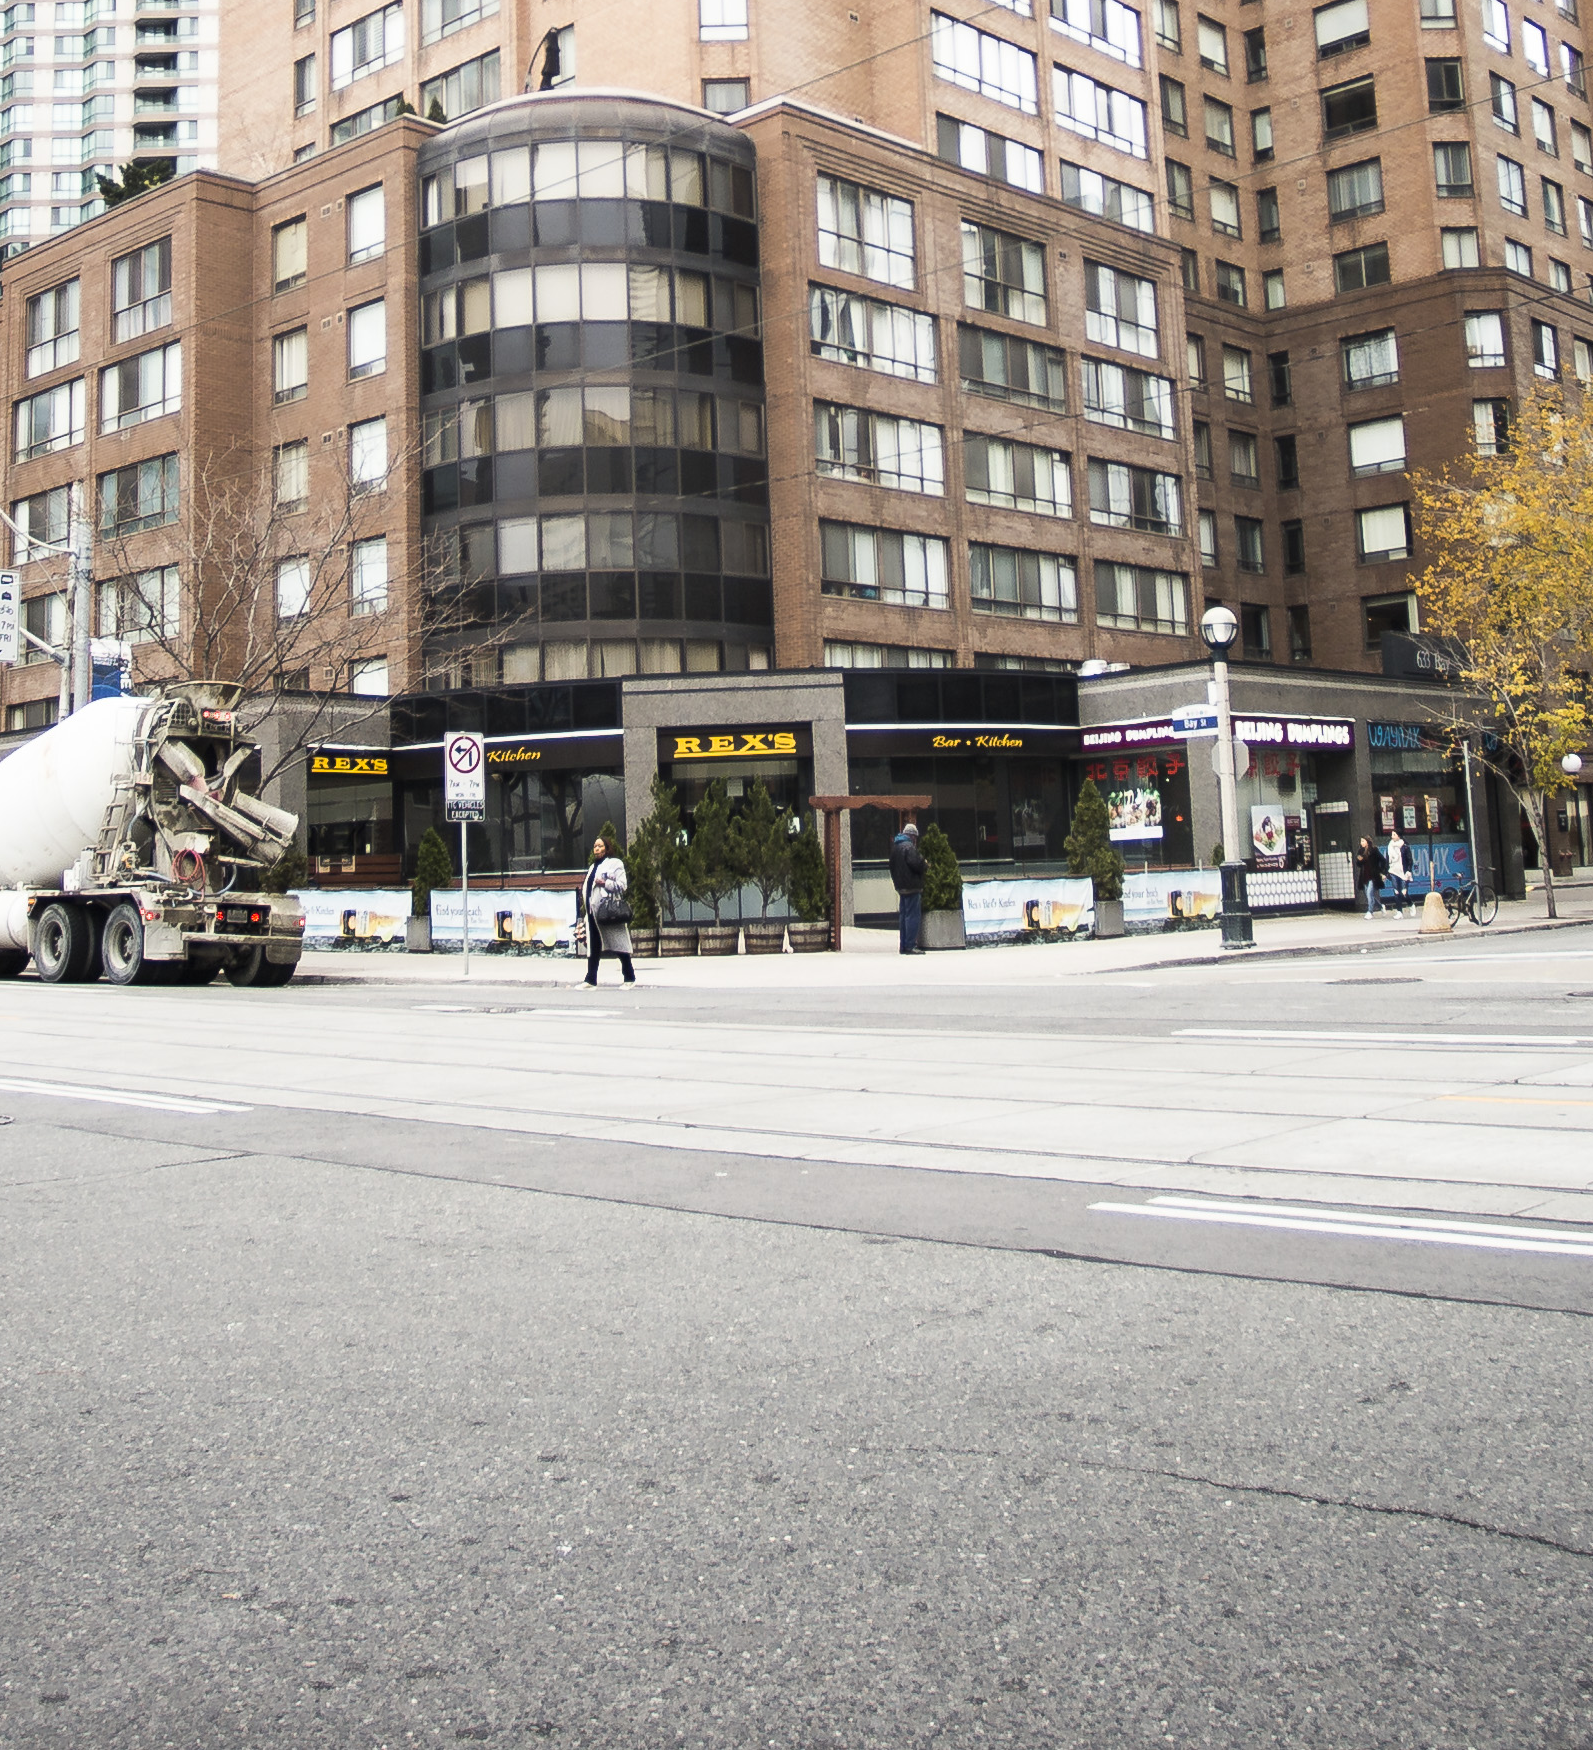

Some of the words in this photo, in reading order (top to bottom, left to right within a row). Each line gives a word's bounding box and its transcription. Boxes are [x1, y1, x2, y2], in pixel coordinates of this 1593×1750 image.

[1183, 718, 1198, 730] Bay
[1083, 730, 1122, 746] BEIJING
[1235, 720, 1283, 742] BEIJING
[1286, 722, 1350, 745] DUMPLINGS
[674, 733, 797, 754] REX'S
[932, 735, 962, 748] Bar
[975, 734, 1024, 748] Kitchen
[486, 747, 541, 763] Kitchen
[312, 756, 388, 772] REX'S
